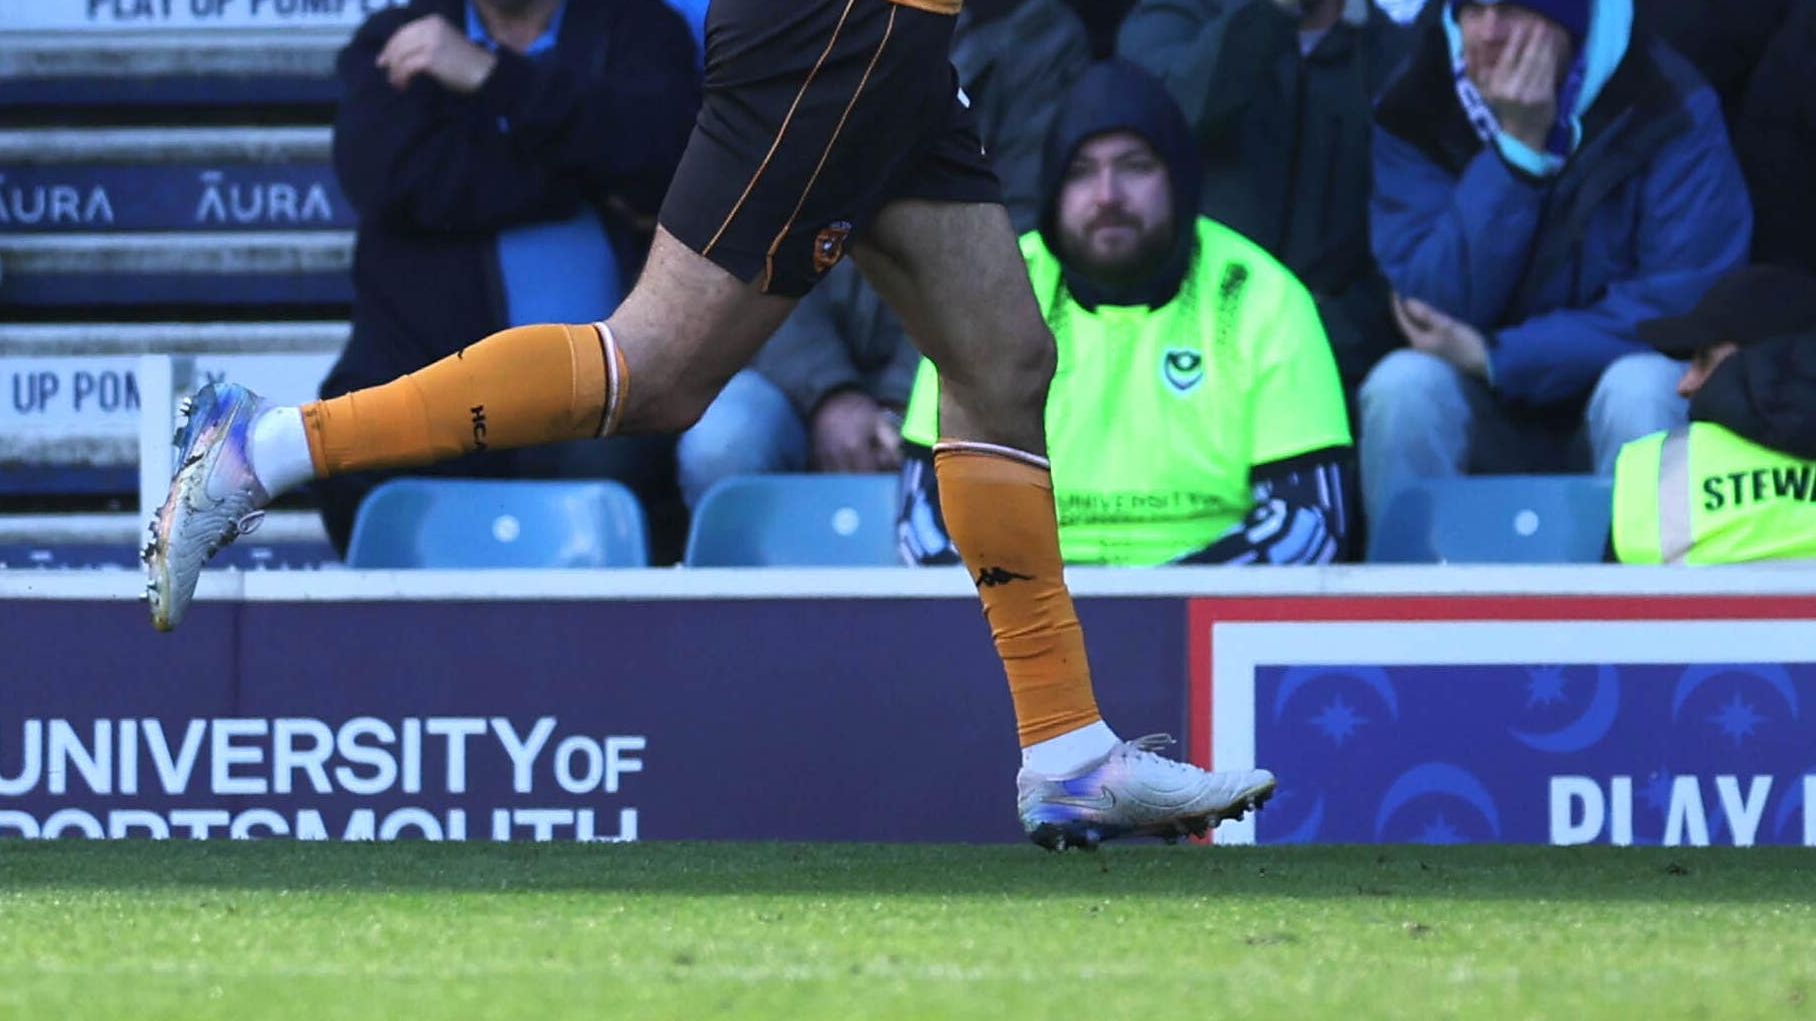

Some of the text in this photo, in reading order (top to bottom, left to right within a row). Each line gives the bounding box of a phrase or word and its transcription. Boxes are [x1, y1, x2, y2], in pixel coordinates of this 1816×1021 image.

[12, 372, 59, 413] UP
[1703, 467, 1816, 511] STEW
[553, 735, 646, 794] OF
